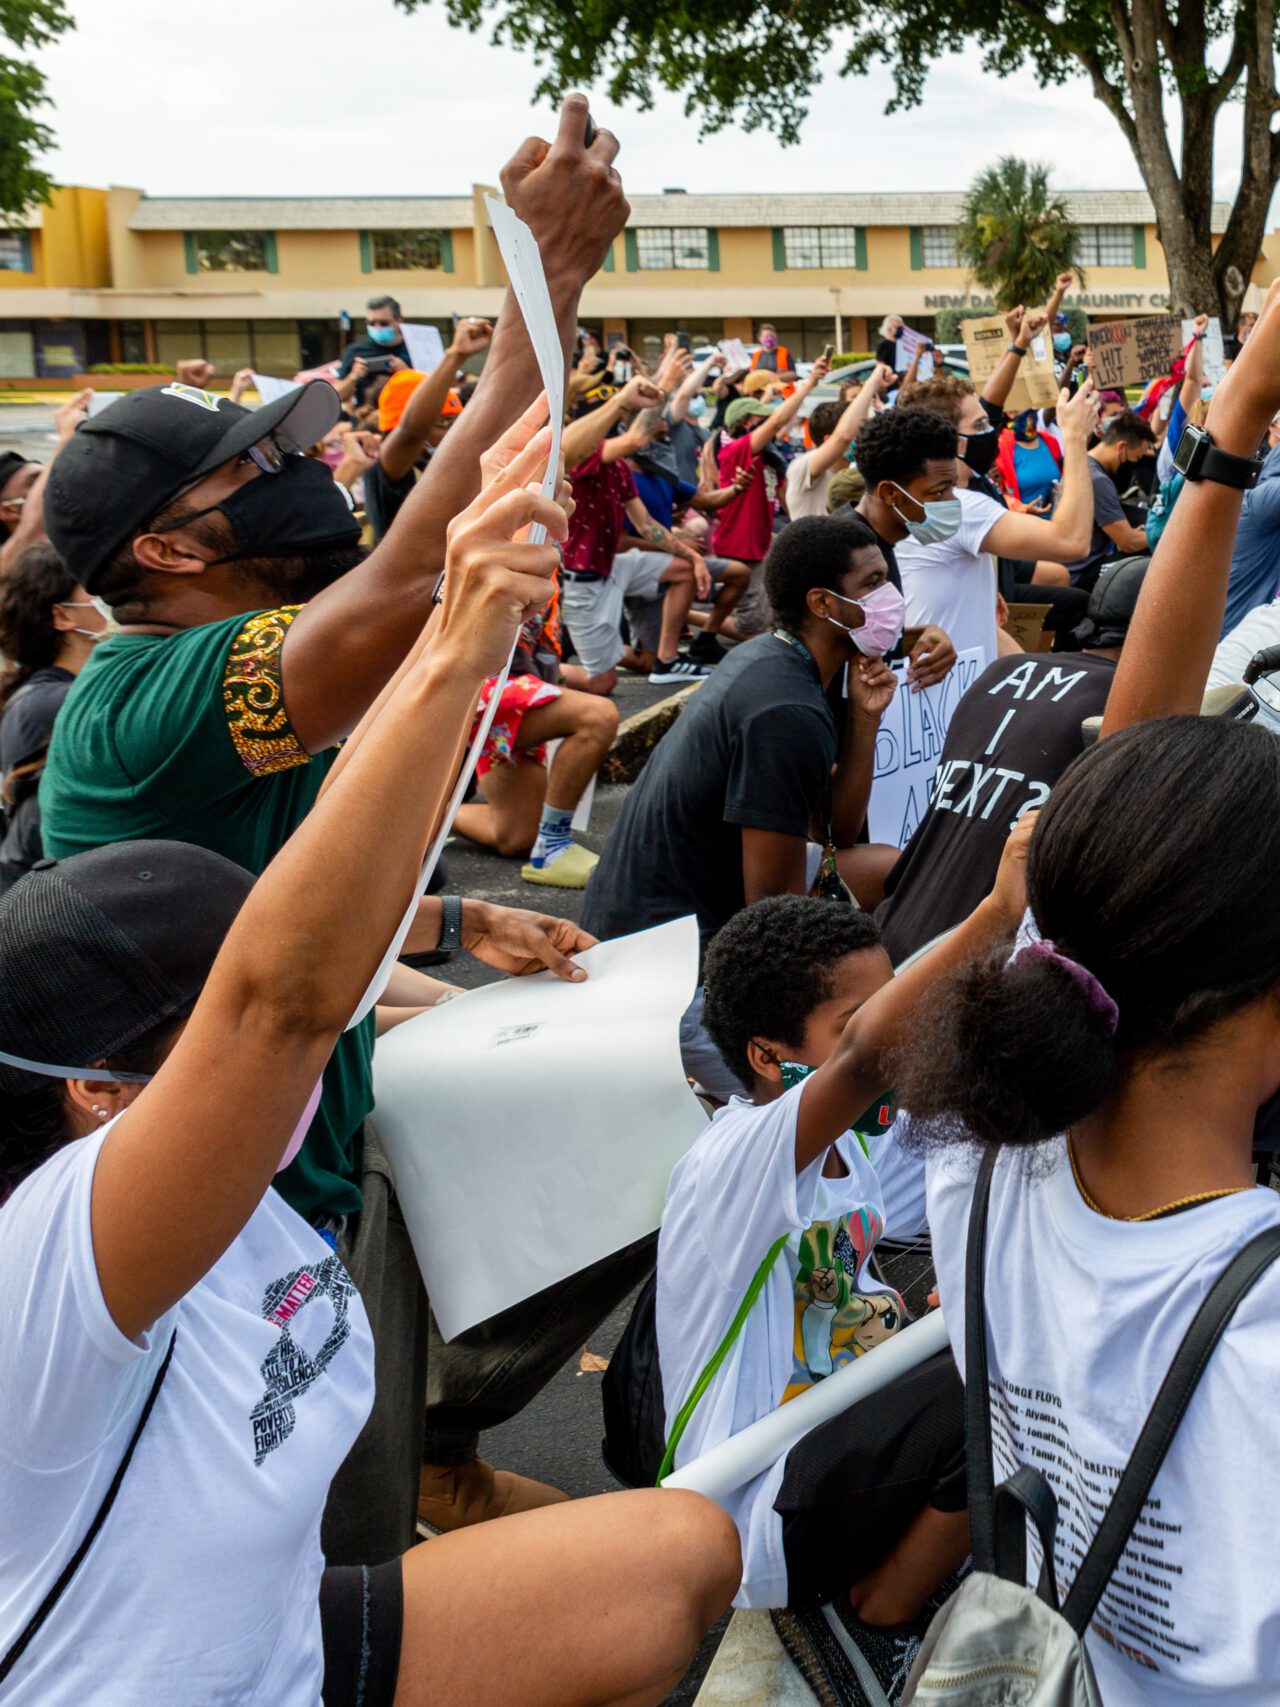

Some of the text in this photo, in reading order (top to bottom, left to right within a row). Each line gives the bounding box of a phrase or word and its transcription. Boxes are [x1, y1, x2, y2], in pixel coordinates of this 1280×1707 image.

[924, 295, 966, 308] NEW
[970, 295, 996, 308] DA
[1063, 294, 1144, 307] MMUNITY
[1096, 366, 1124, 387] LIST
[988, 661, 1088, 702] AM
[984, 709, 1016, 755] I
[274, 1272, 316, 1321] MATTER
[254, 1428, 283, 1451] FIGHT
[1031, 1445, 1056, 1463] Tamir
